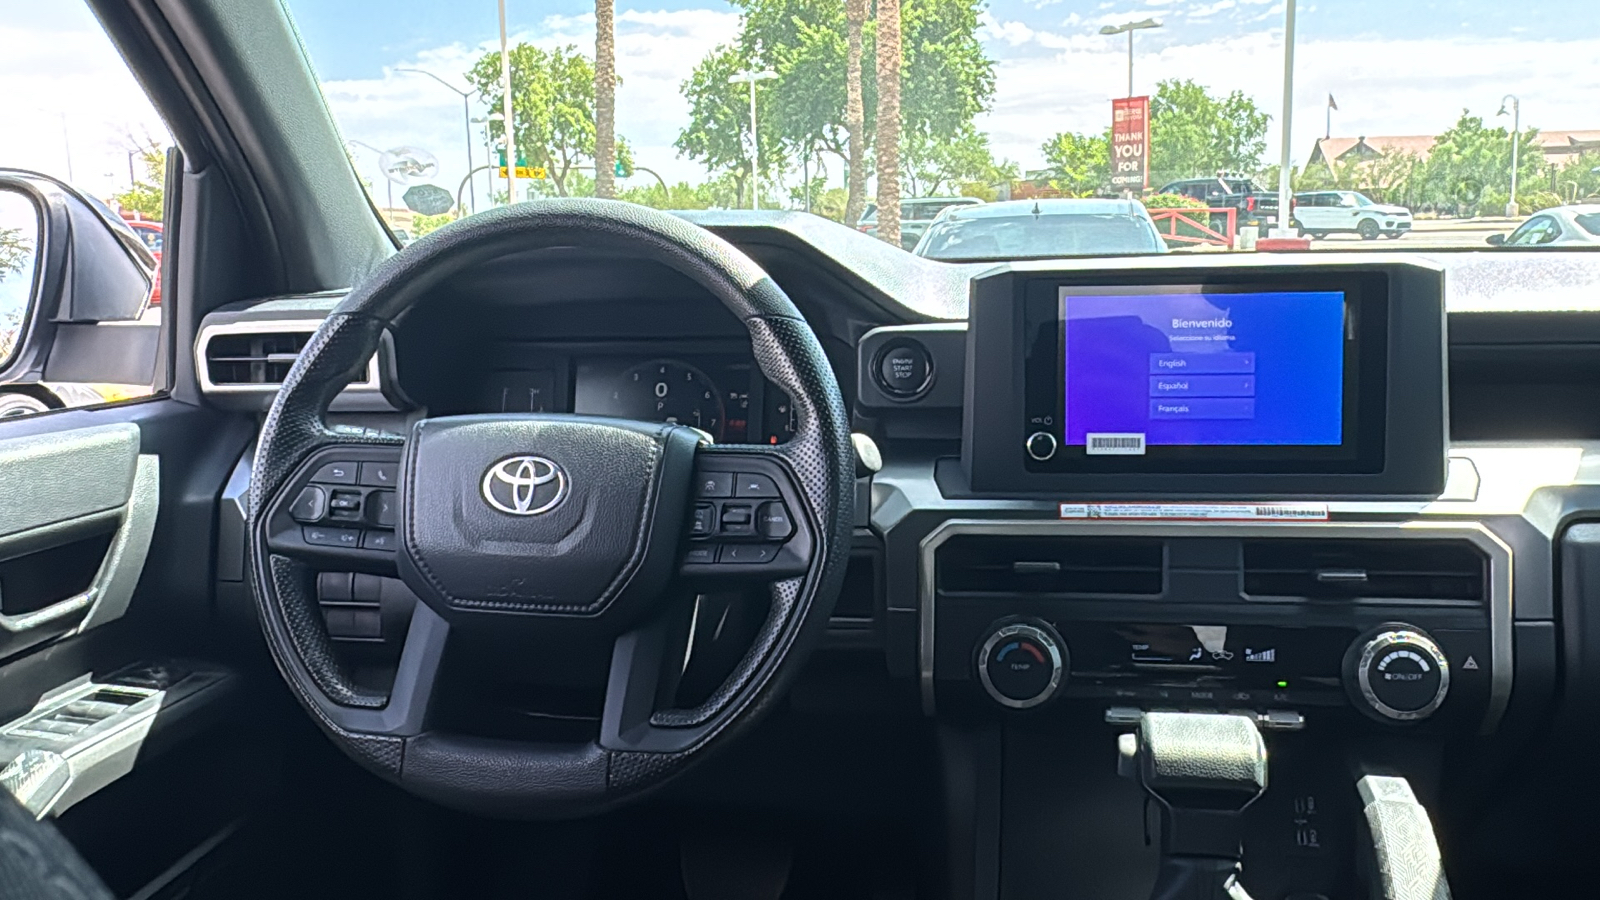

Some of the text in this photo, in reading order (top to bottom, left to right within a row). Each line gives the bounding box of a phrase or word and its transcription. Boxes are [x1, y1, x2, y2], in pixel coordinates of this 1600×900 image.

[1114, 132, 1143, 143] THANK
[1114, 144, 1143, 158] YOU
[1117, 161, 1139, 172] FOR
[1112, 176, 1143, 185] COMING!
[1172, 318, 1232, 329] Bienvenido
[1158, 359, 1187, 369] English
[687, 372, 692, 381] 5
[895, 371, 912, 379] STOP
[1158, 382, 1189, 391] Español
[704, 391, 711, 399] 6
[657, 401, 664, 411] P
[1158, 405, 1190, 413] Français
[710, 418, 717, 427] 7
